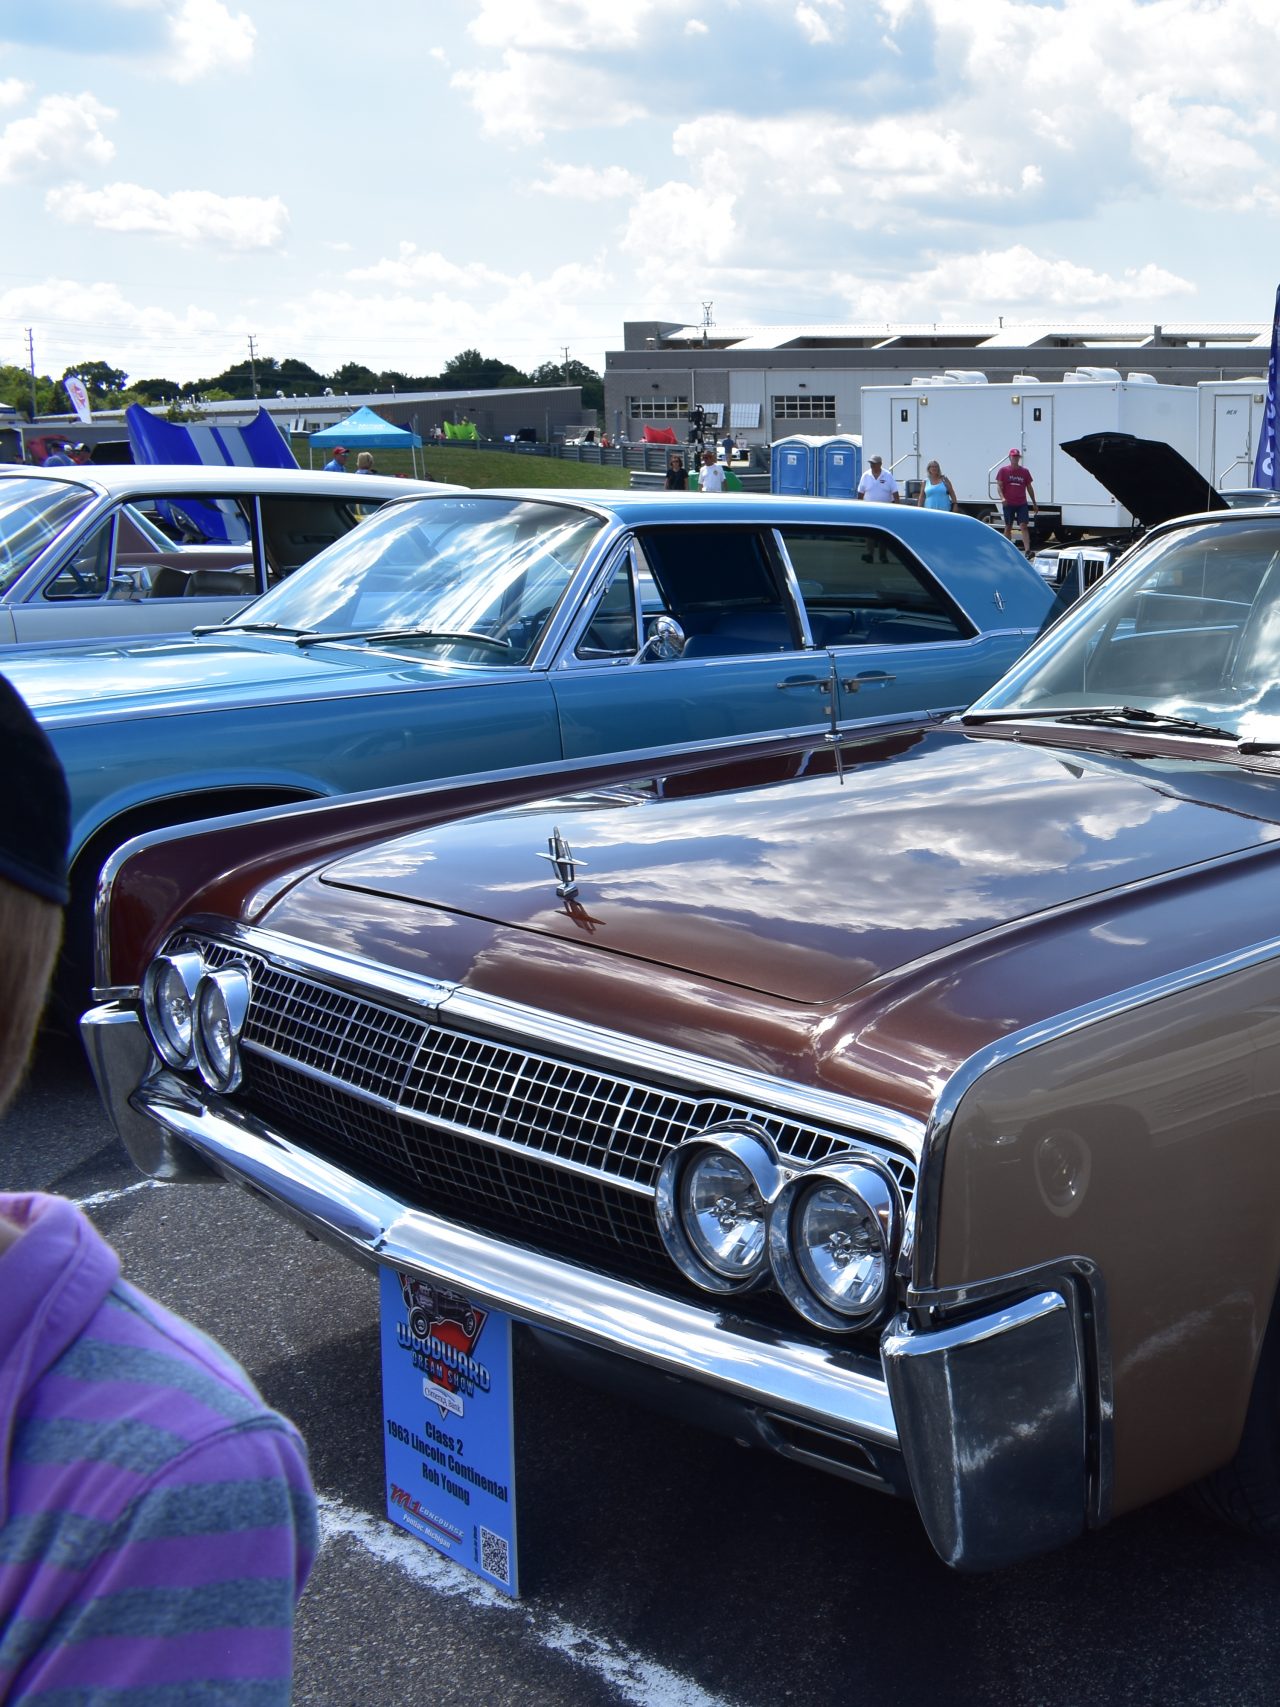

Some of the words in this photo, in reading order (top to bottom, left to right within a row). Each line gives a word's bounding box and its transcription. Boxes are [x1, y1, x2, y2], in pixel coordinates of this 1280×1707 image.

[396, 1321, 490, 1391] WOODWARD
[412, 1351, 443, 1378] DREAM
[447, 1370, 474, 1395] SHOW
[387, 1419, 410, 1445] 1963
[411, 1433, 446, 1467] Lincoln
[448, 1454, 508, 1502] Continental
[425, 1421, 455, 1452] Class
[456, 1438, 464, 1456] 2
[422, 1462, 440, 1486] Rob
[441, 1473, 470, 1506] Young
[419, 1504, 465, 1537] CONCOURSE
[424, 1527, 451, 1549] Michigan
